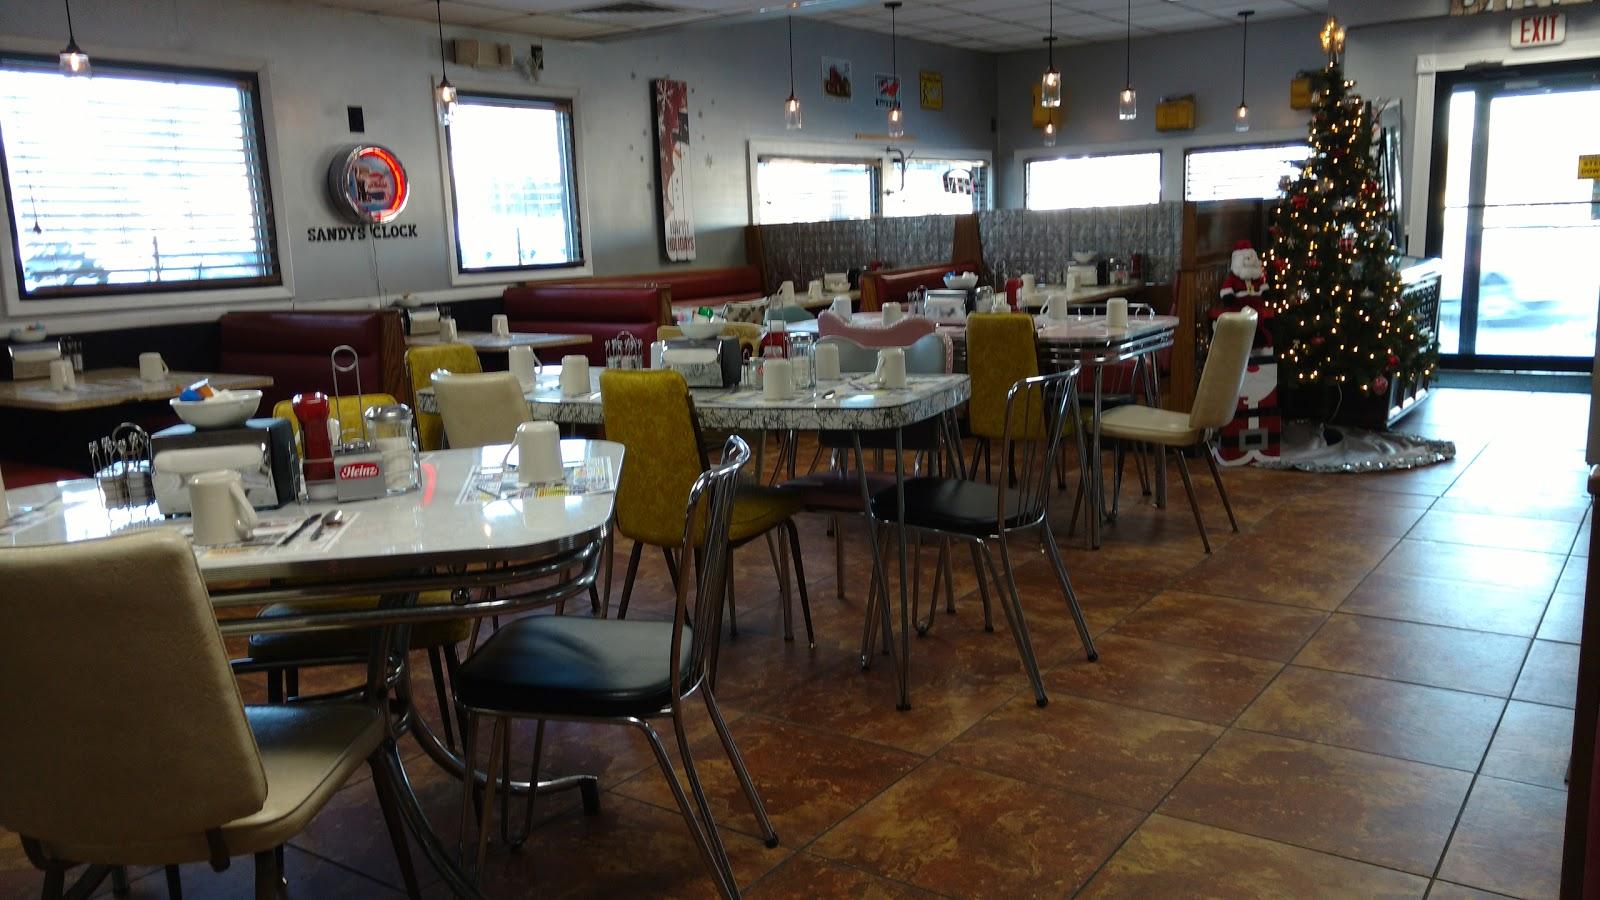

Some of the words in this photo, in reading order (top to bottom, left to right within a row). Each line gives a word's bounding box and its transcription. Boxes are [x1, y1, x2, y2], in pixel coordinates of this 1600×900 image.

[1519, 13, 1559, 44] EXIT
[372, 223, 418, 239] CLOCK
[669, 219, 690, 236] HAPPY
[666, 236, 695, 252] HOLIDAYS
[341, 464, 378, 479] Heinz
